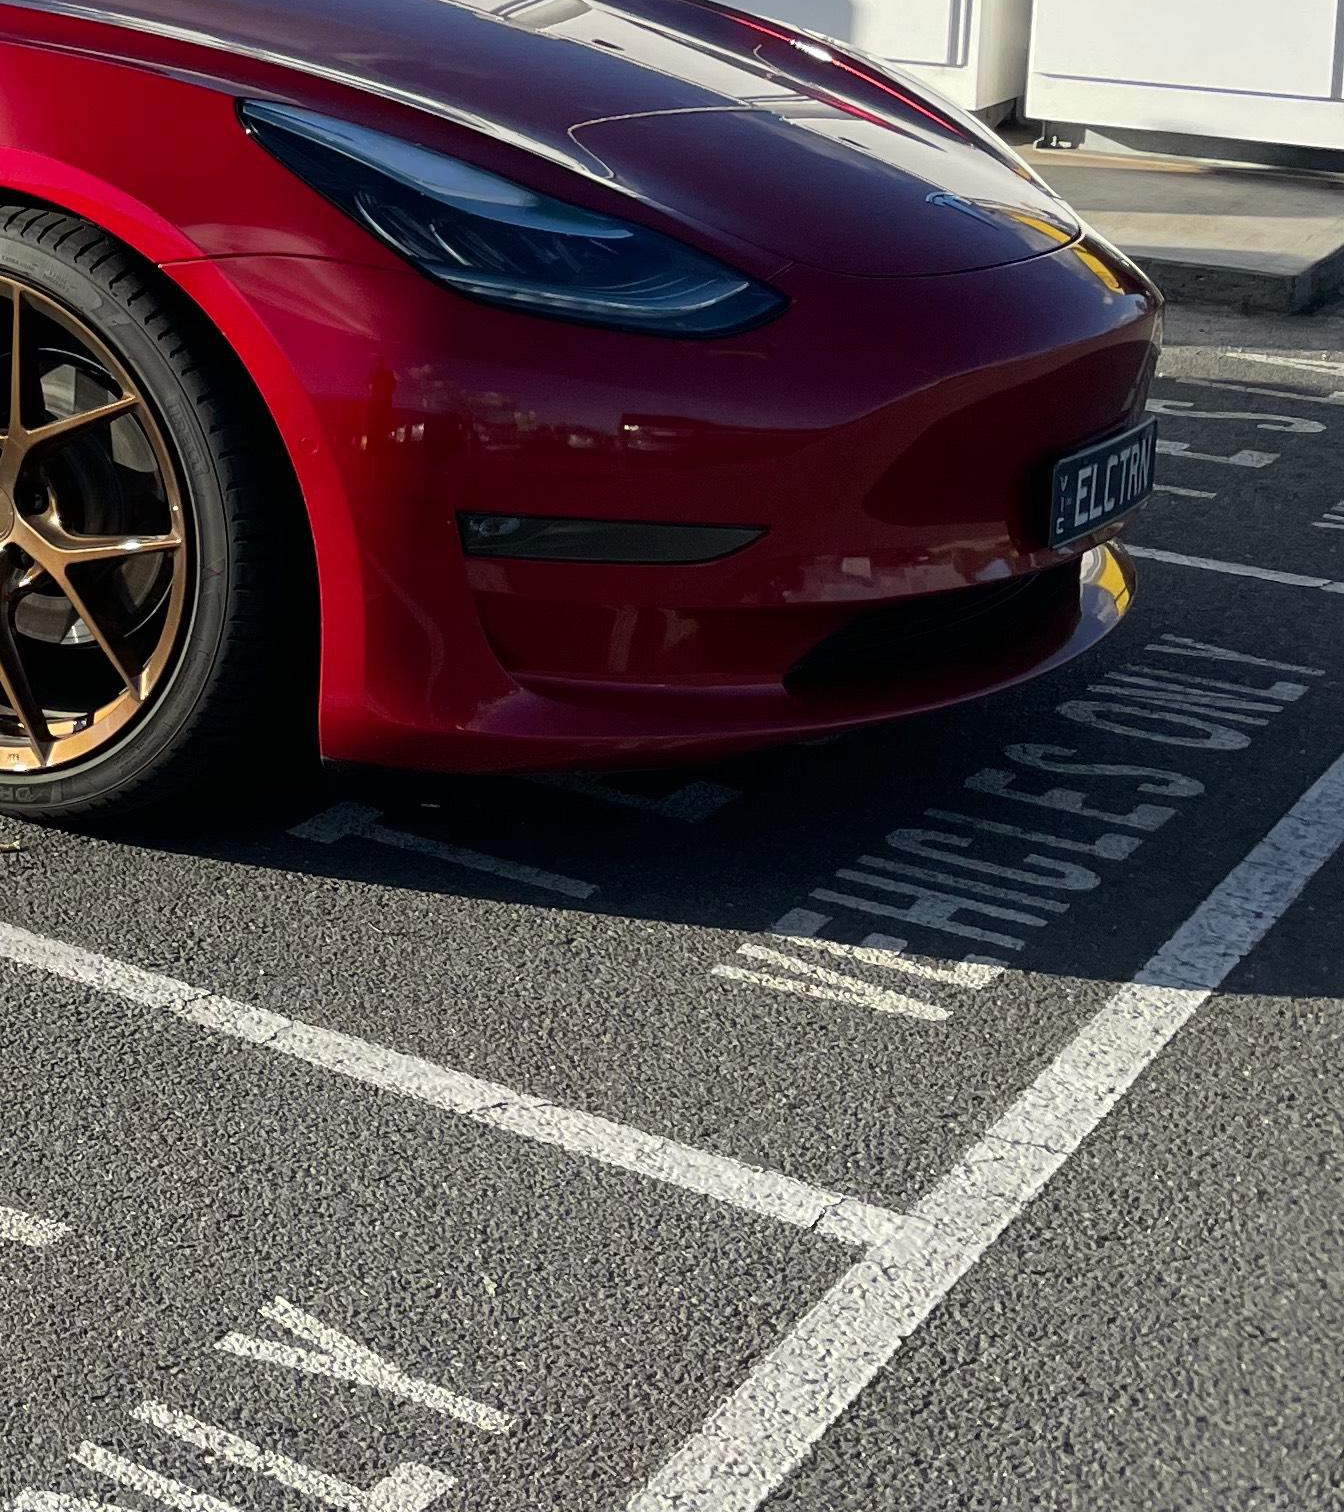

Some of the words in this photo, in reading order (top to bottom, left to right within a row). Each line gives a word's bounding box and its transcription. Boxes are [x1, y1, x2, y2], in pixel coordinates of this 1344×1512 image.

[1055, 474, 1068, 535] VIC
[1074, 434, 1153, 528] ELCTRN
[711, 741, 1205, 1022] VEHICLES
[1055, 633, 1327, 751] ONLY
